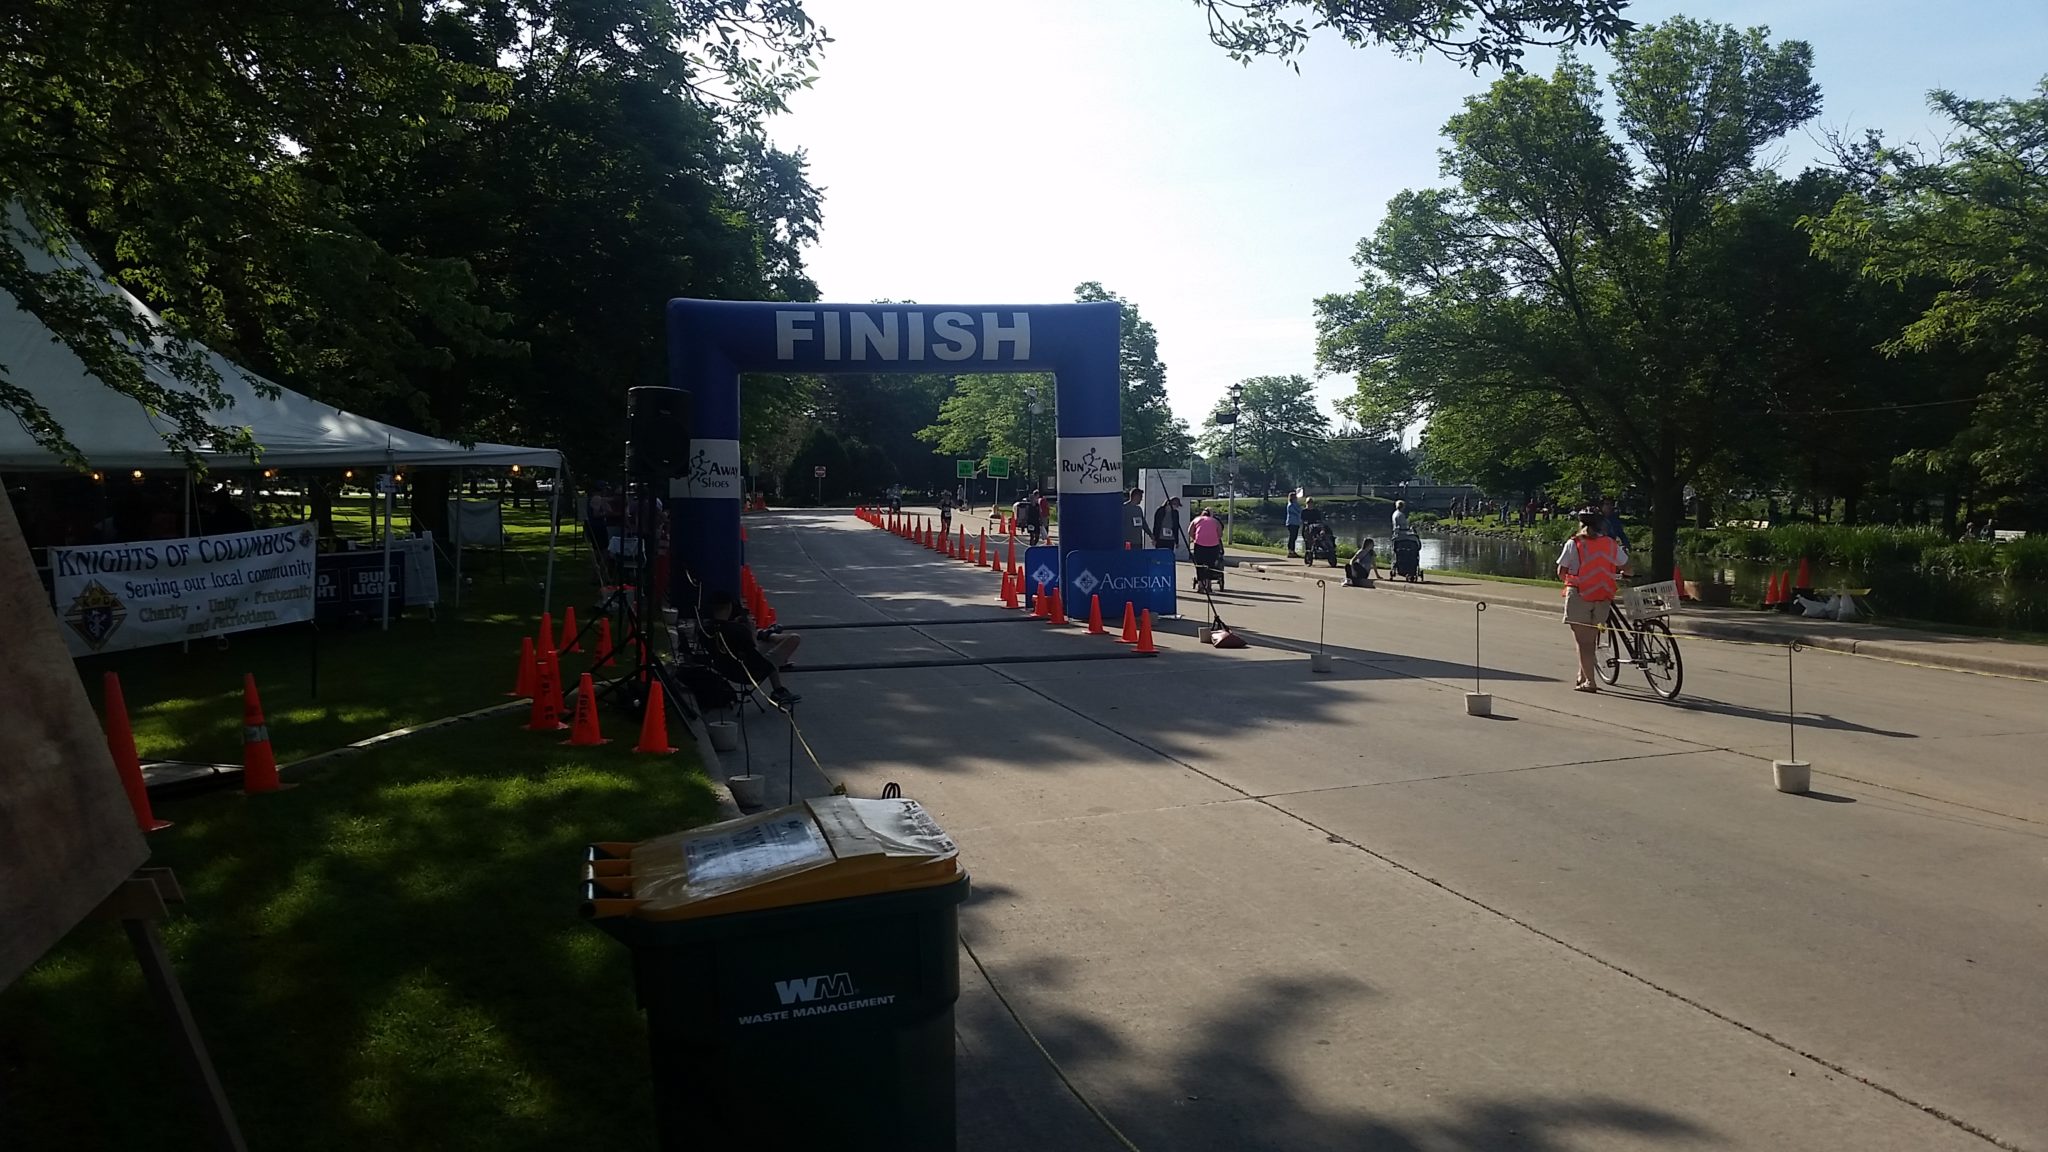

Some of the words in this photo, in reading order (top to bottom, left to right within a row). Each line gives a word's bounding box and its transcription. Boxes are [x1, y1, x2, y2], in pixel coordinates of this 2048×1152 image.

[776, 310, 1031, 361] FINISH
[1062, 459, 1085, 472] RUN
[1093, 473, 1117, 484] SHOES
[701, 477, 730, 488] SHOES
[56, 547, 158, 577] KNIGHTS
[166, 544, 190, 567] OF
[199, 532, 296, 563] COLUMBUS
[125, 578, 180, 599] Serving
[184, 576, 207, 592] our
[212, 569, 243, 588] local
[248, 560, 313, 584] community
[1099, 572, 1172, 590] AGNESIAN
[140, 604, 189, 622] Charity
[208, 595, 240, 613] Unity
[254, 585, 313, 605] Fraternity
[186, 618, 210, 634] and
[213, 610, 277, 630] Patriotism
[774, 971, 854, 1006] WM
[738, 1010, 789, 1025] WASTE
[792, 994, 896, 1018] MANAGEMENT
